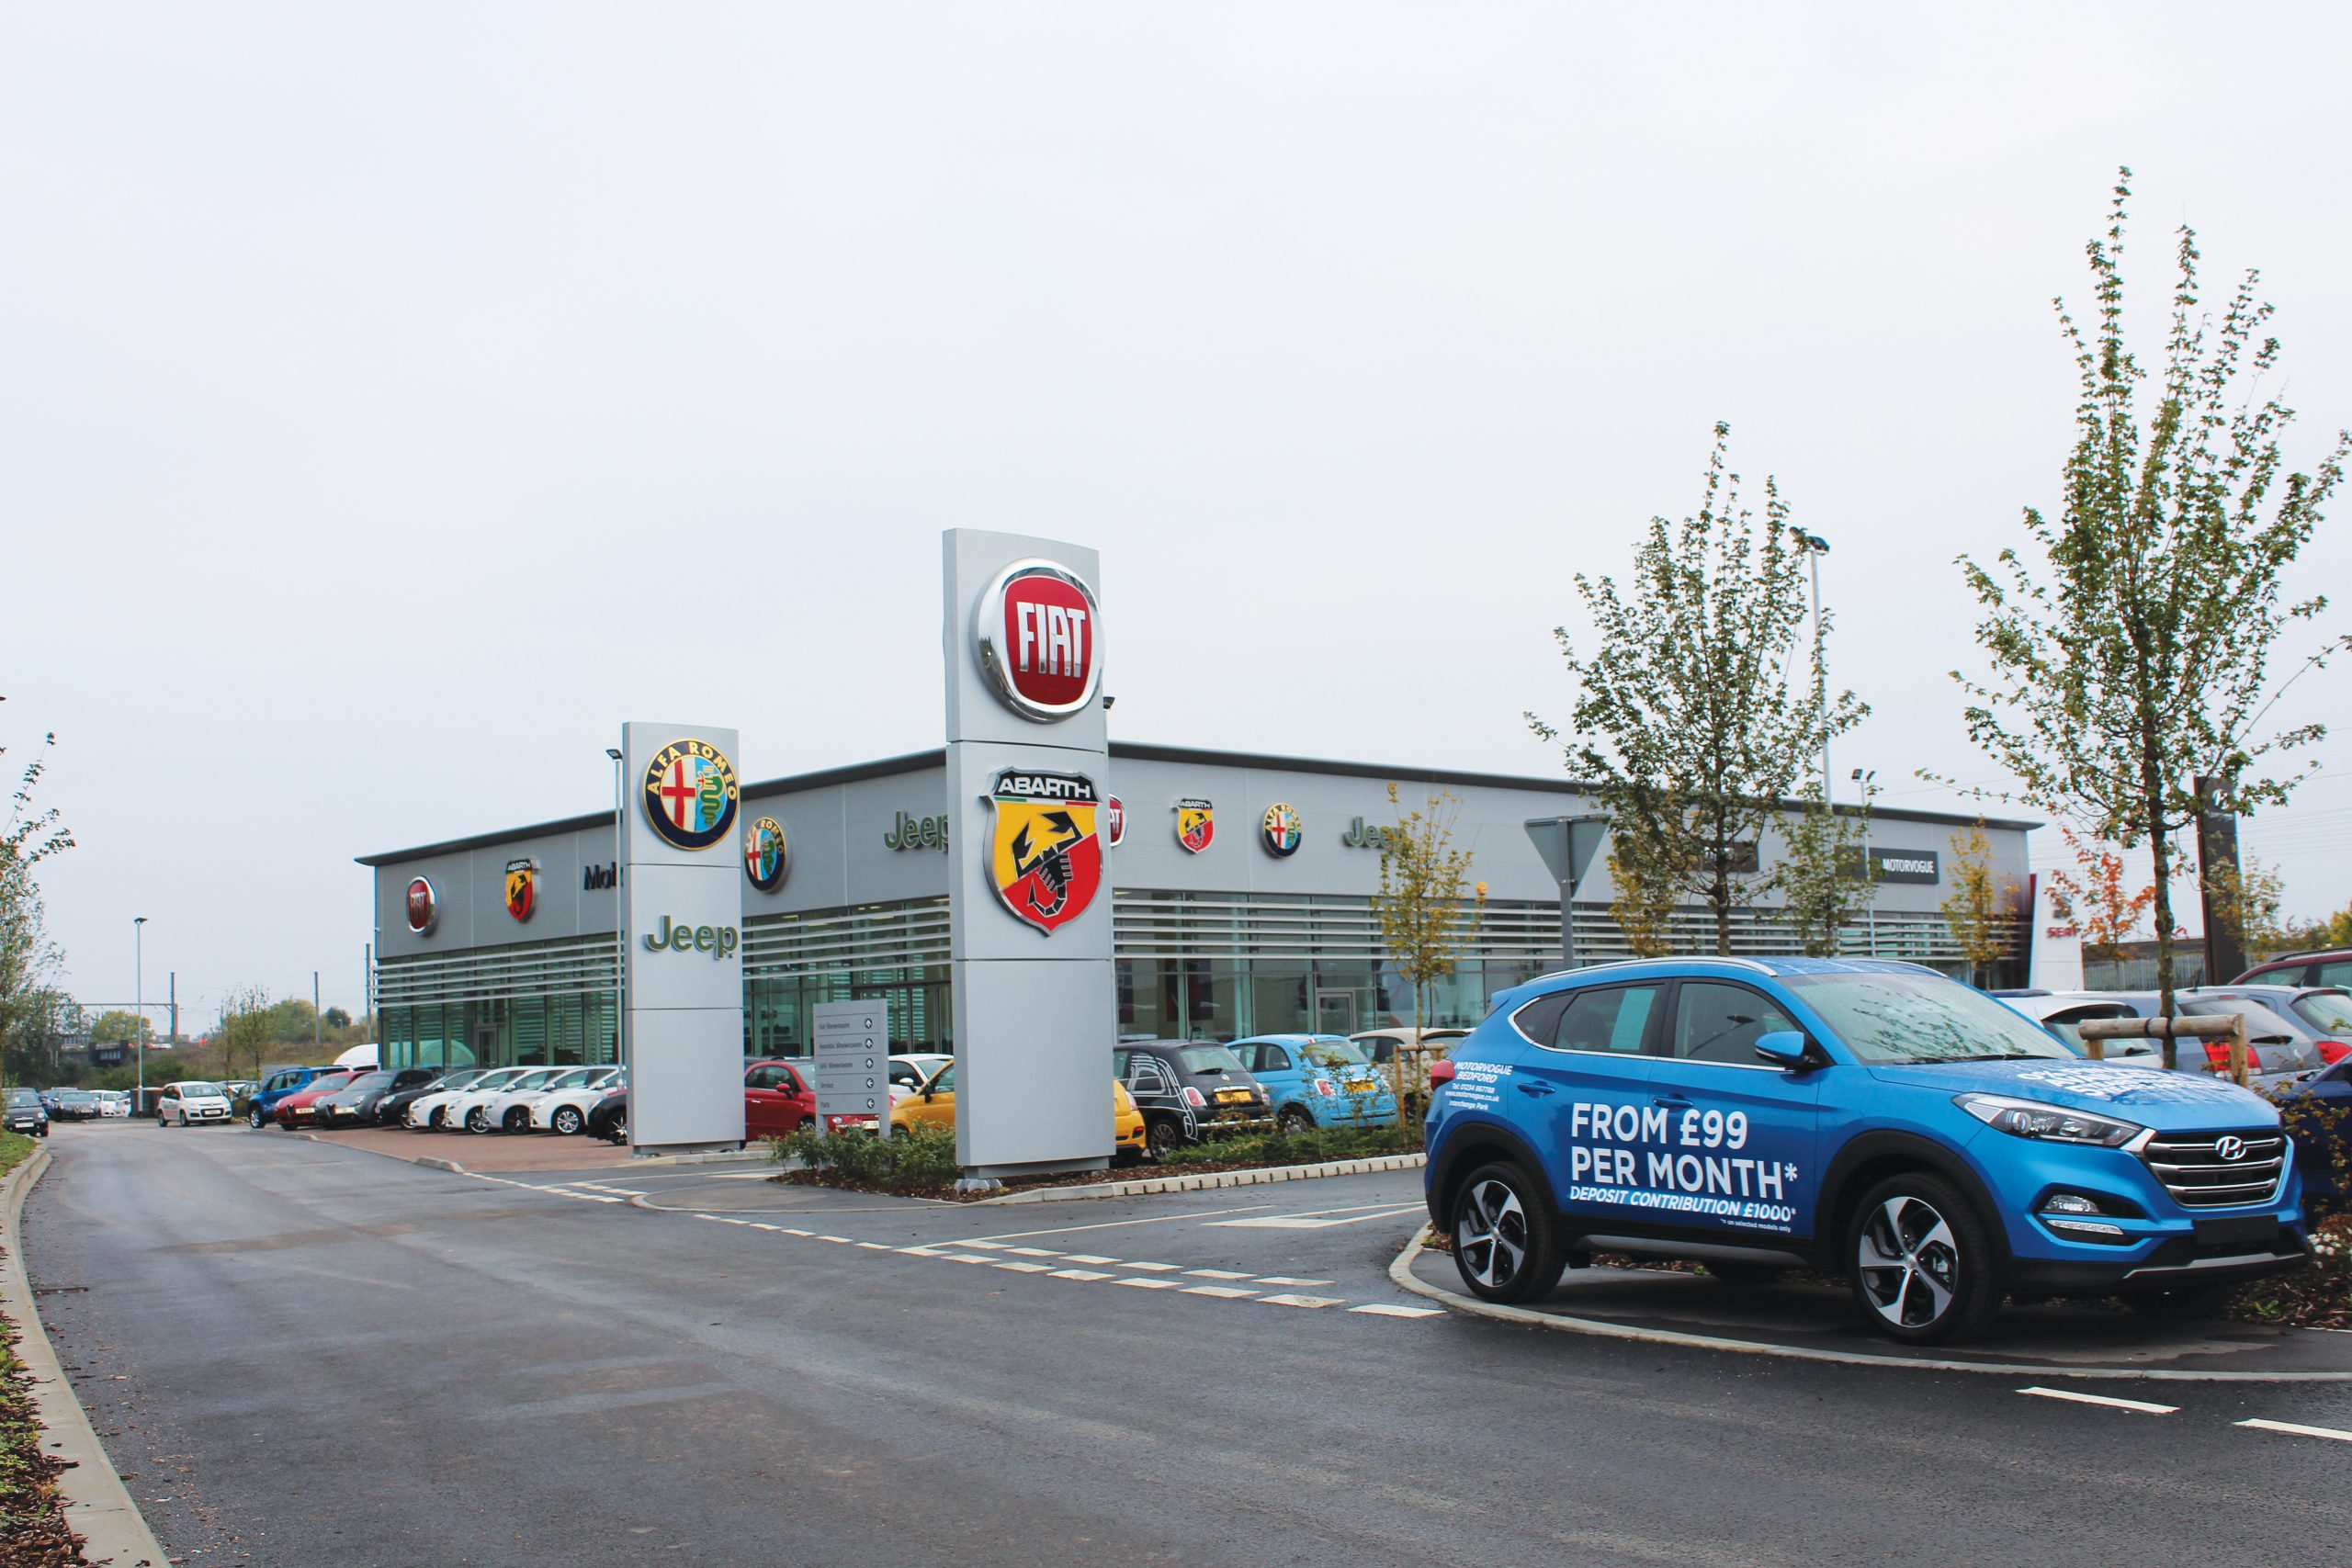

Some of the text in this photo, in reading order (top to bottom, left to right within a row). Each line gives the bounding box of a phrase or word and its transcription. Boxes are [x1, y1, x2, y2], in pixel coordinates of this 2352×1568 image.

[1016, 601, 1086, 678] FIAT
[647, 741, 738, 800] ALFA ROMEO
[998, 776, 1091, 798] ABARTH
[1180, 799, 1211, 808] ABARTH
[507, 861, 531, 871] ABARTH
[1881, 858, 1935, 874] MOTORVOGUE
[644, 915, 739, 959] Jeep
[1454, 1062, 1512, 1075] MOTORVOGUE
[1456, 1071, 1498, 1083] BEDFORD
[1571, 1102, 1748, 1150] FROM £99
[1571, 1145, 1638, 1186] PER
[1569, 1185, 1629, 1204] DEPOSIT
[1629, 1190, 1743, 1216] CONTRIBUTION
